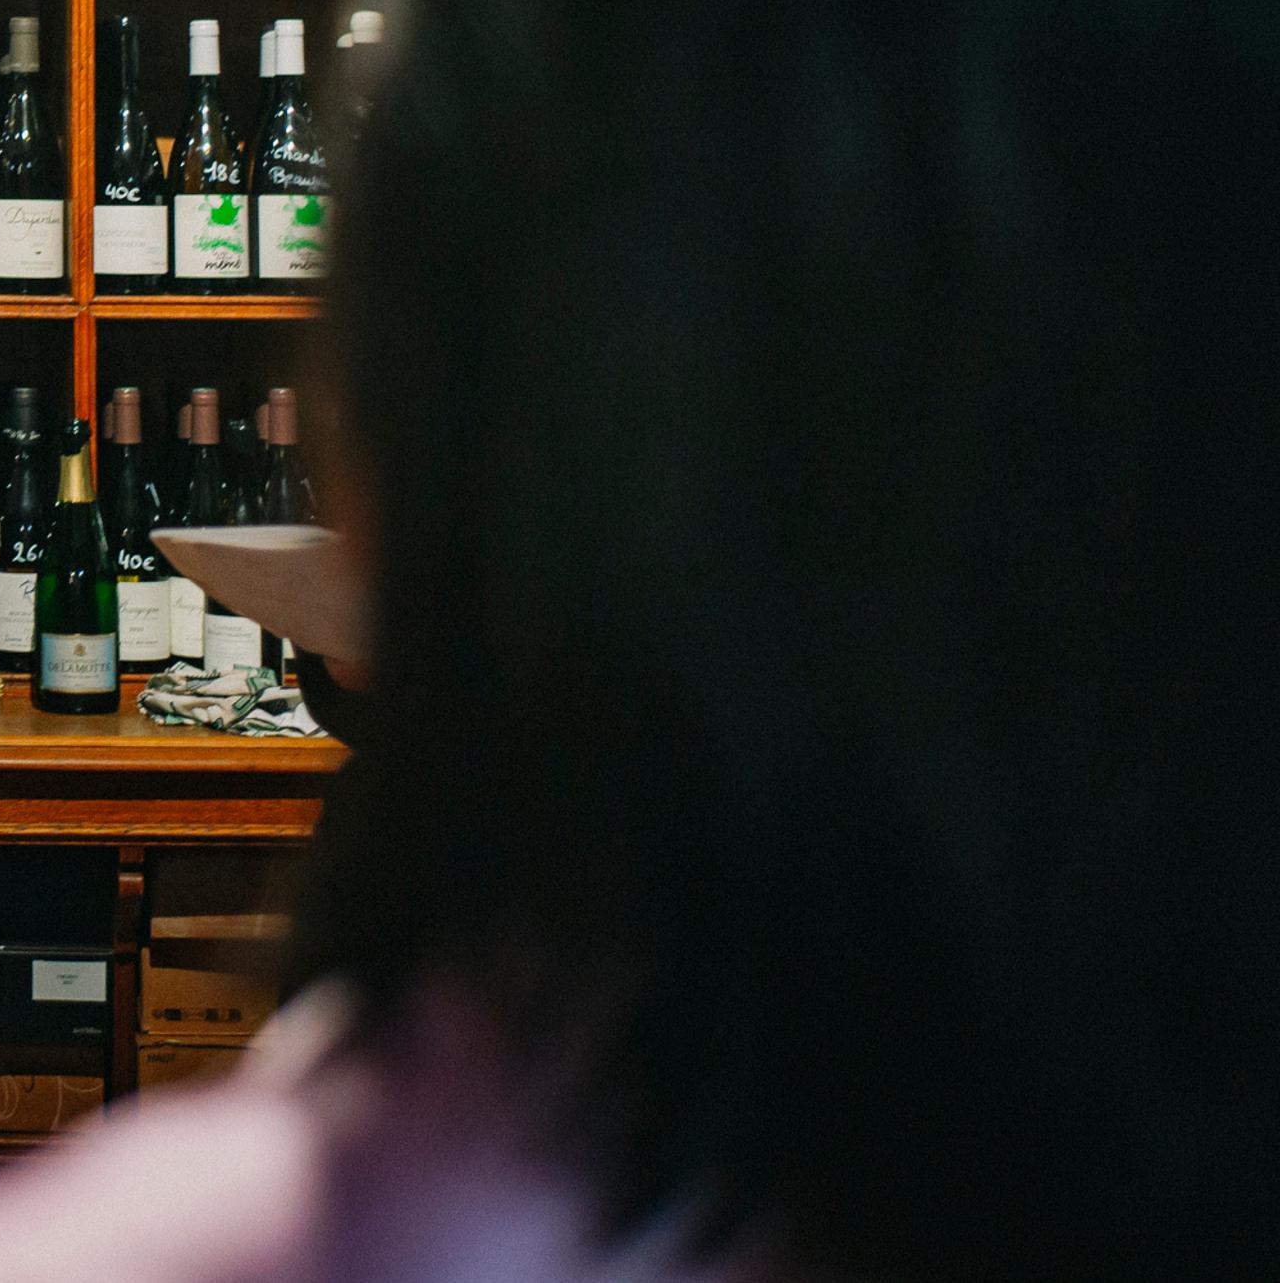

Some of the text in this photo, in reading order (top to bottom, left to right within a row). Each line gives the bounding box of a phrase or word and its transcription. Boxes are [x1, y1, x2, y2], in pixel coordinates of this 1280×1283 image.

[204, 161, 241, 185] 18€
[105, 183, 142, 202] 40€
[12, 542, 43, 564] 26
[117, 549, 156, 572] 40€
